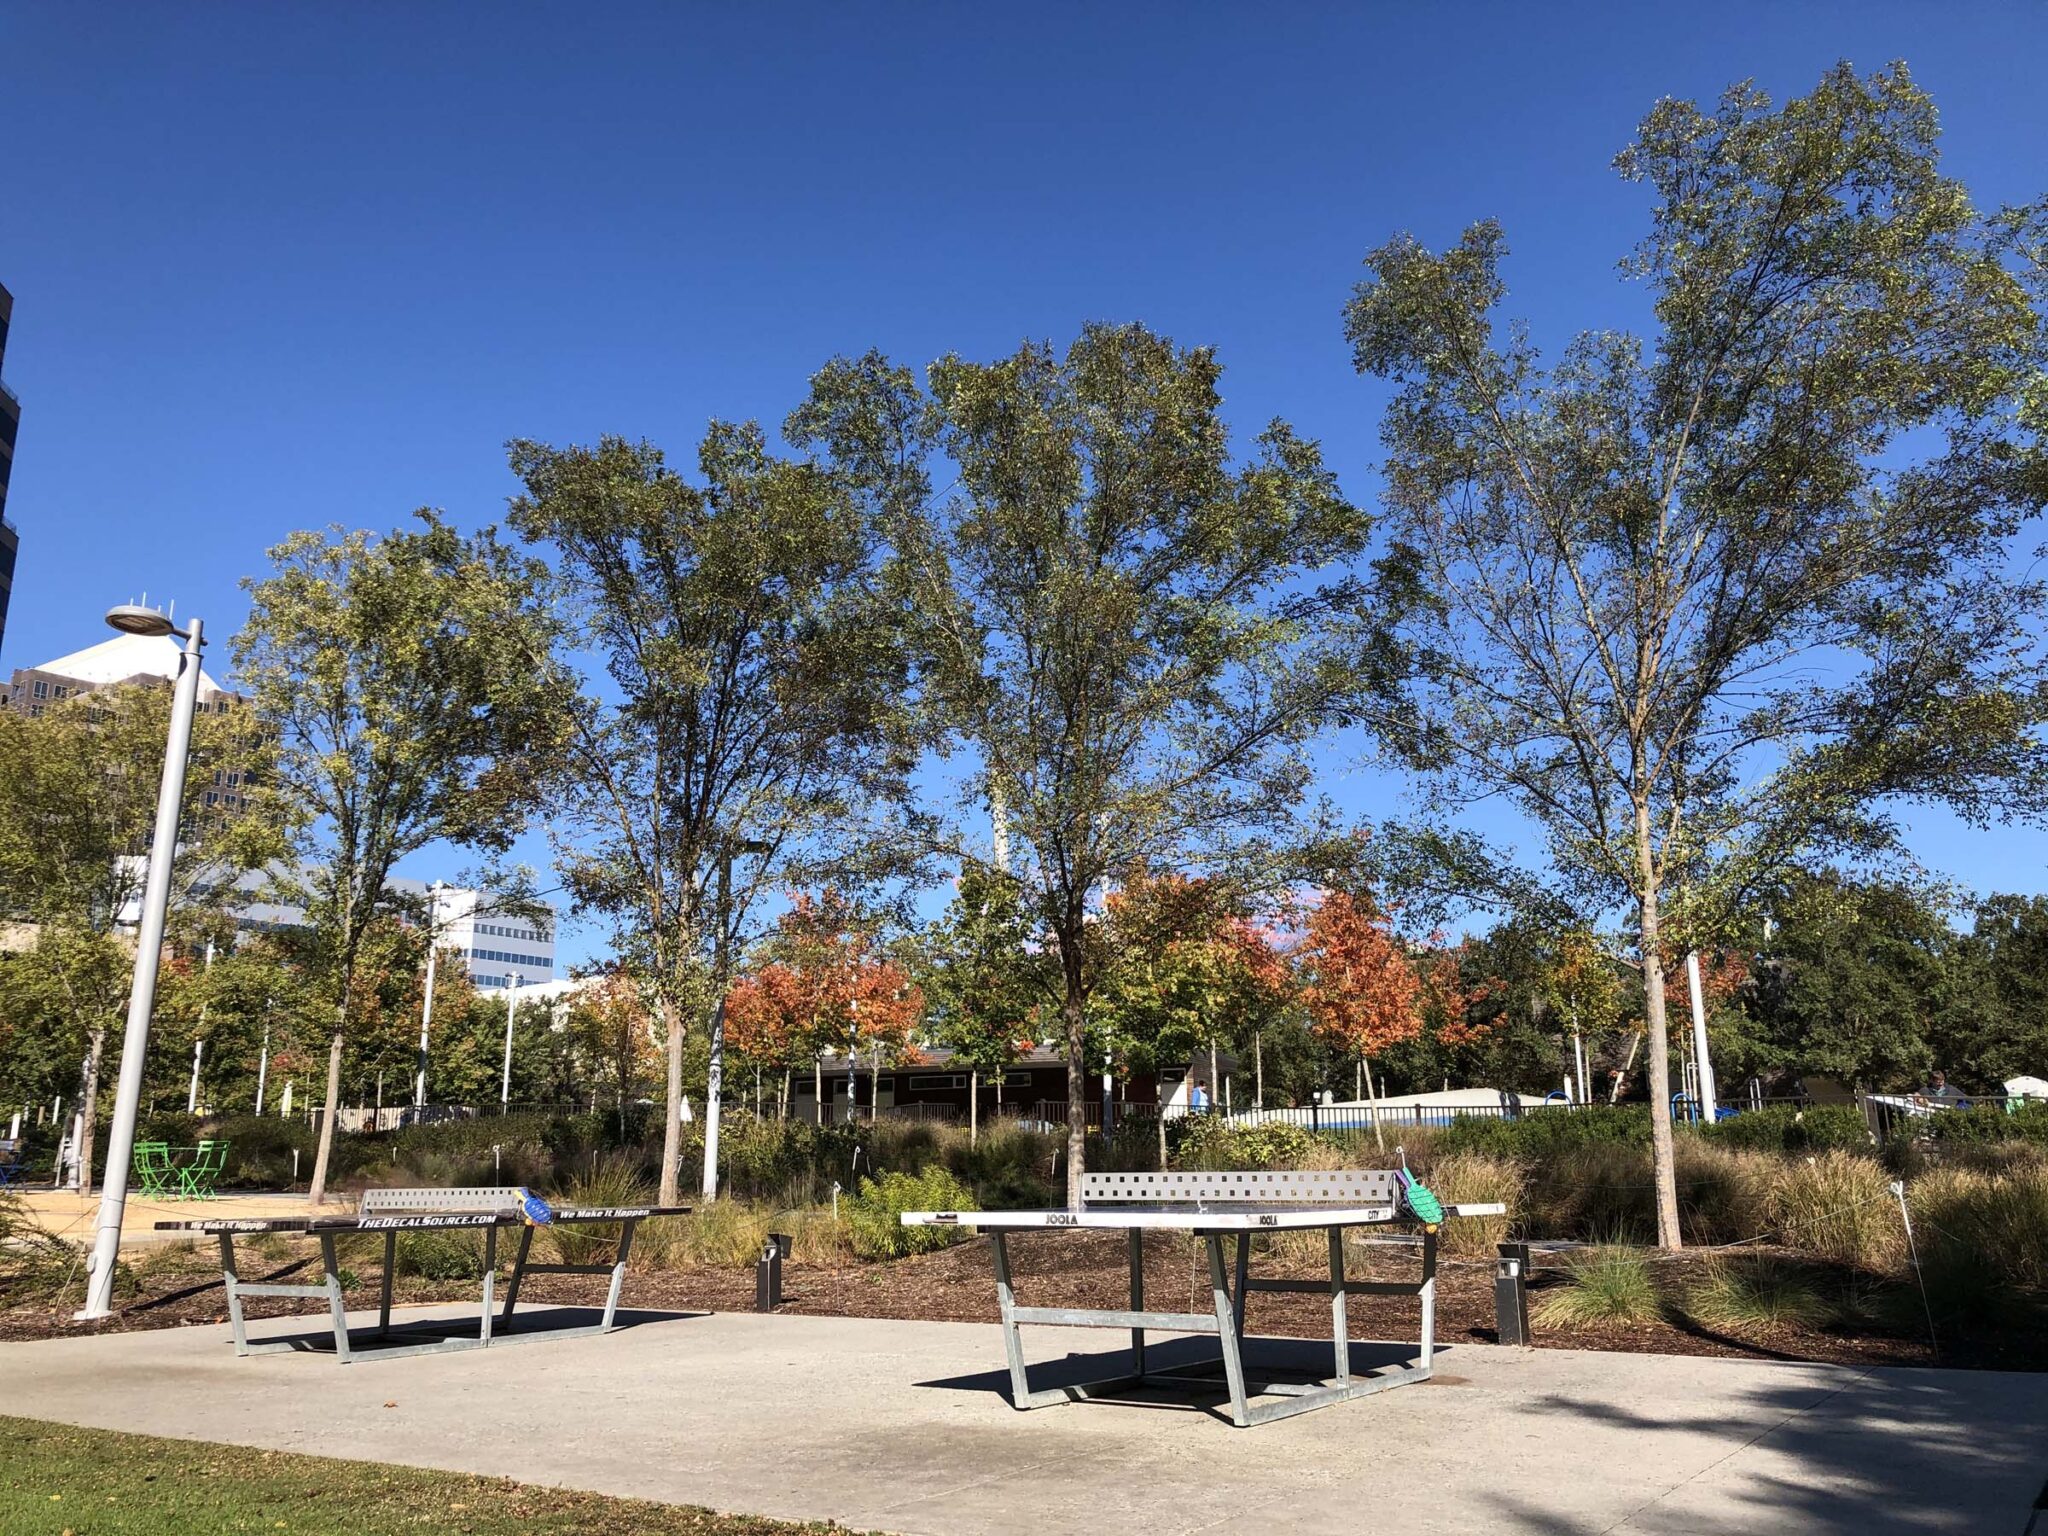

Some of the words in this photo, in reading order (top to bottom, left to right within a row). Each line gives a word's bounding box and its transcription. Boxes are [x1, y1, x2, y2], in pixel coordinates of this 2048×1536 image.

[560, 1210, 575, 1219] We
[576, 1209, 602, 1218] Make
[614, 1208, 650, 1217] Happen
[1368, 1210, 1379, 1220] CITY
[191, 1221, 203, 1229] We
[203, 1221, 226, 1229] Make
[235, 1221, 268, 1229] Happen
[1045, 1215, 1078, 1225] JOOLA
